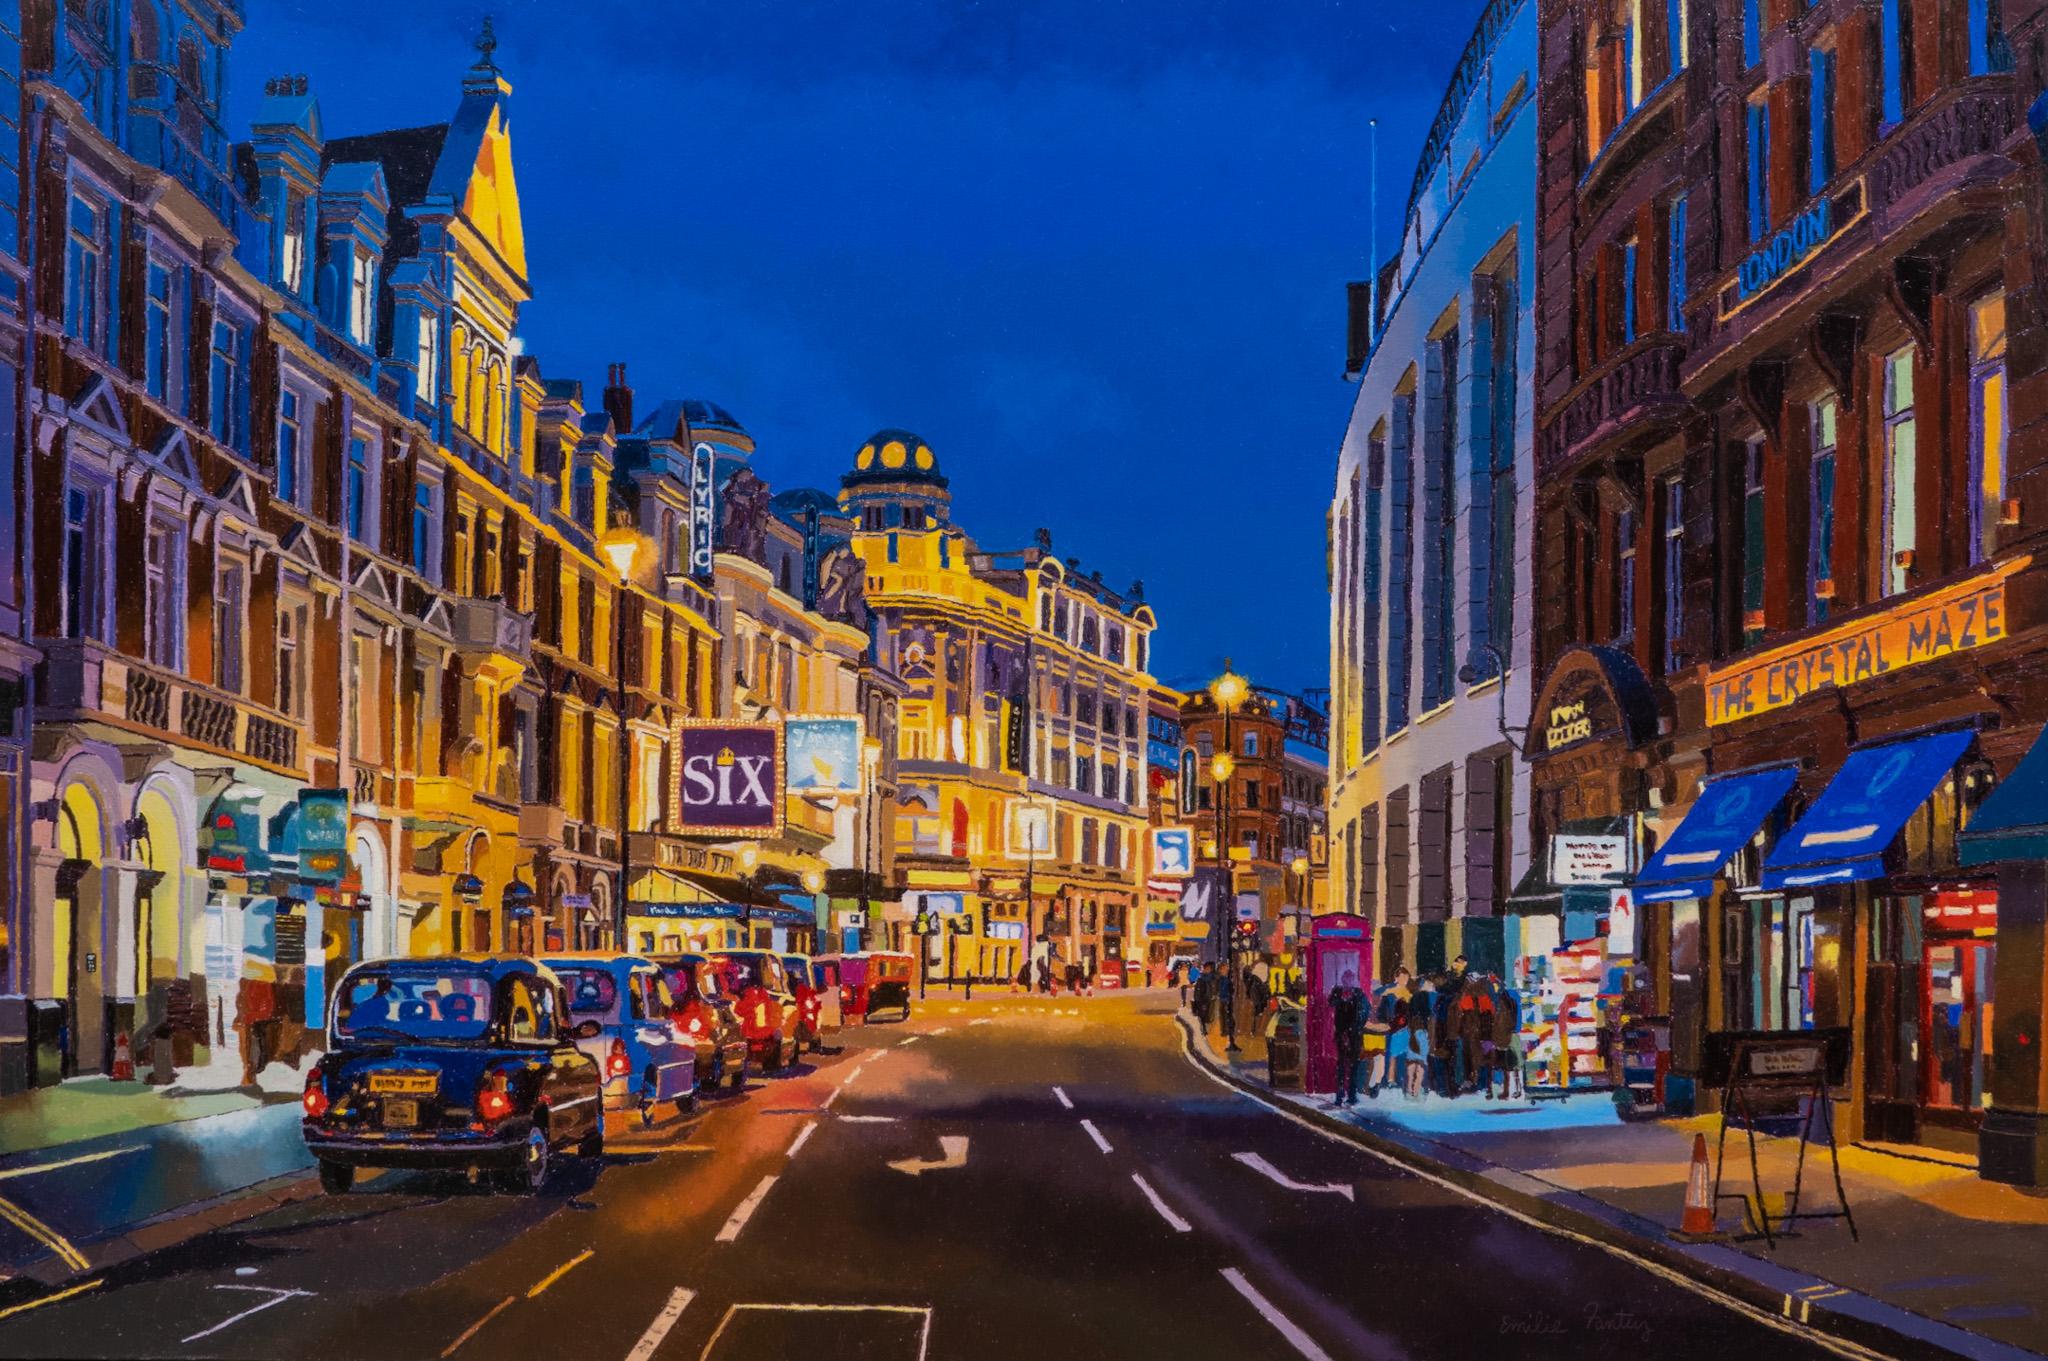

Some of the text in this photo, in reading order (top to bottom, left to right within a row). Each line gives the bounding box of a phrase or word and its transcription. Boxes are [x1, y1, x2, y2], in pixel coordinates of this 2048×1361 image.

[1738, 198, 1831, 300] LONDON
[694, 465, 710, 567] LYRIC
[1709, 590, 2003, 721] THE CRYSTAL MAZE
